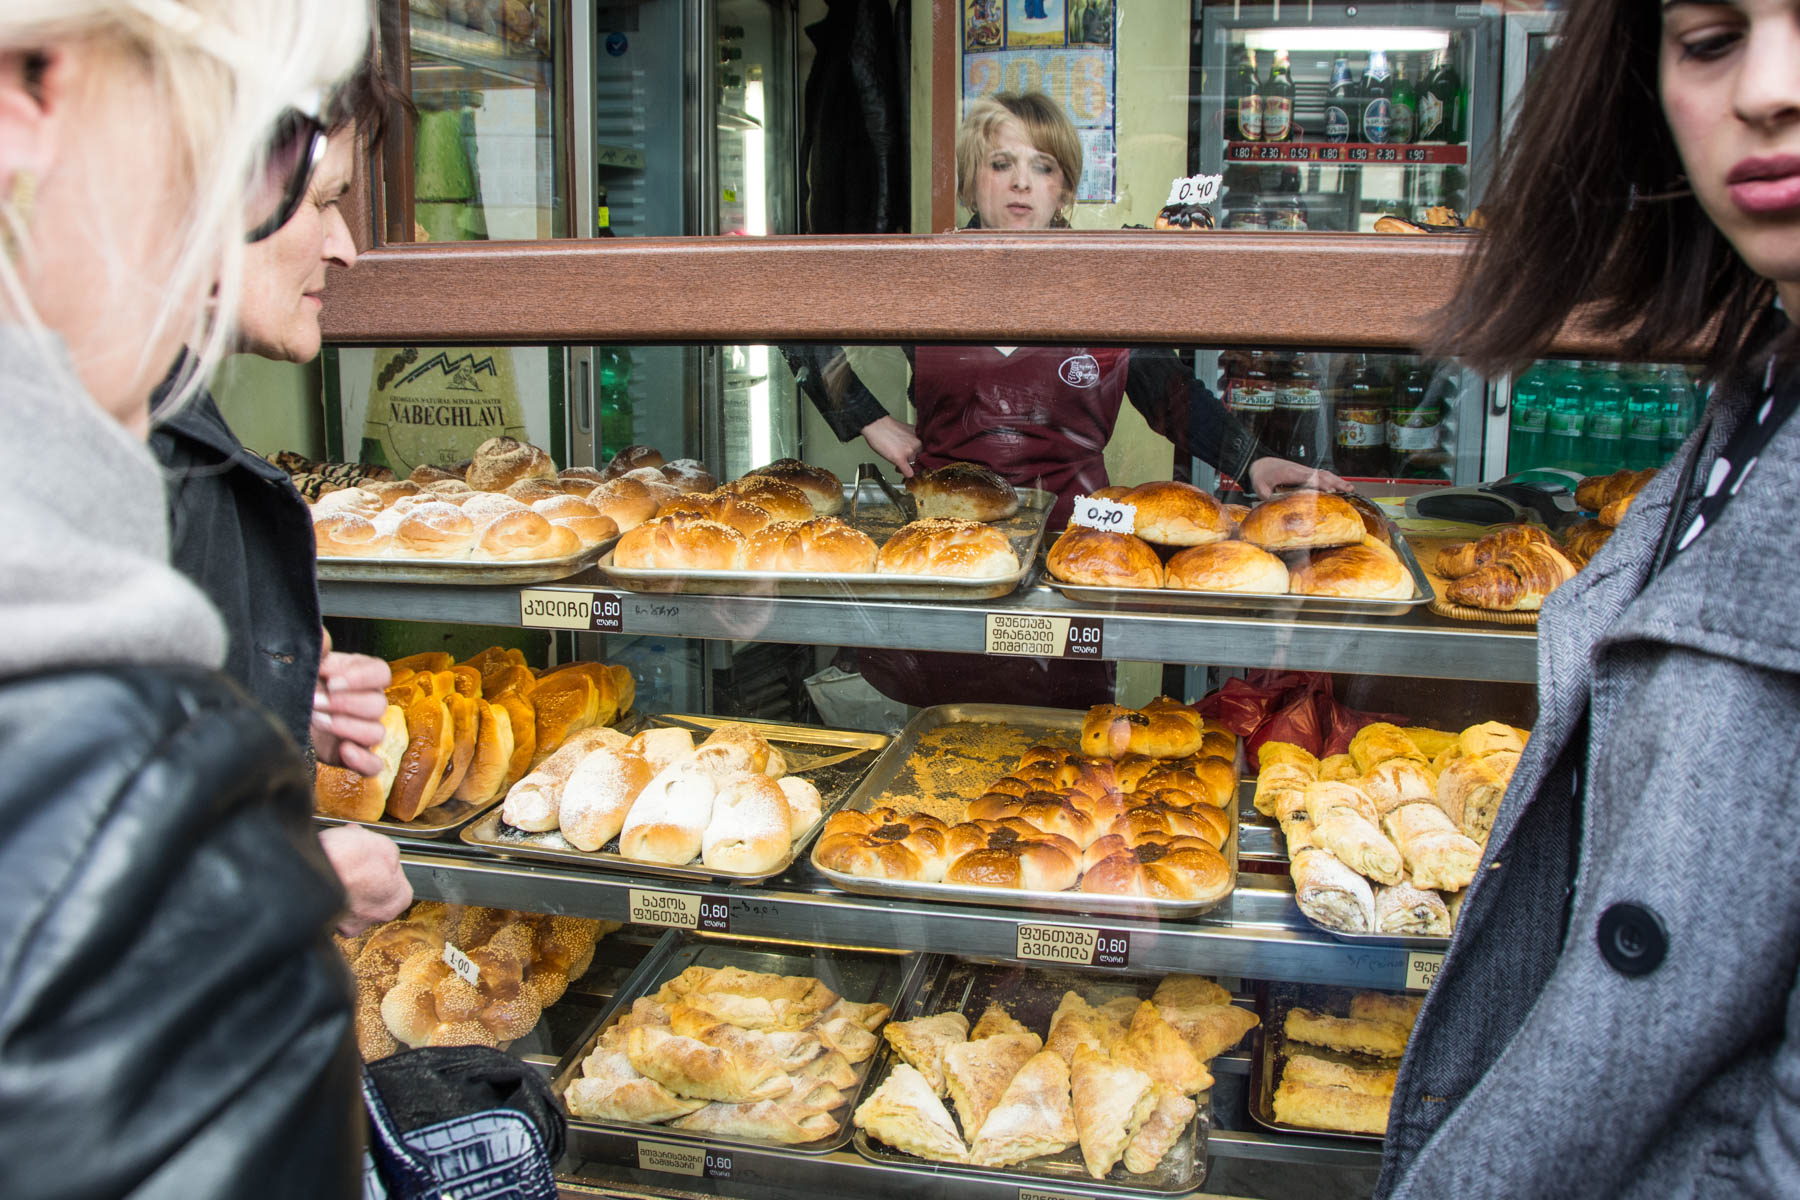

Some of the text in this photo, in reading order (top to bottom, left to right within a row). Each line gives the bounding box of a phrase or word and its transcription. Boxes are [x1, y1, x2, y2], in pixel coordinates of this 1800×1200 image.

[969, 55, 1107, 120] 2016
[1235, 147, 1250, 159] 1.80
[1322, 148, 1338, 159] 1.80
[389, 402, 506, 427] NABEGHLAVI
[524, 600, 589, 618] კულიჩი
[593, 601, 620, 616] 0,60
[995, 616, 1052, 630] ფუნთუშა
[992, 626, 1100, 643] ფრანგული 0,60
[992, 641, 1054, 654] ქიშმიშით
[642, 895, 686, 911] ხაჭოს
[633, 907, 697, 926] ფუნთუშა
[701, 903, 728, 919] 0,60
[1019, 926, 1094, 946] ფუნთუშა
[1022, 938, 1127, 961] გვირილა 0,60
